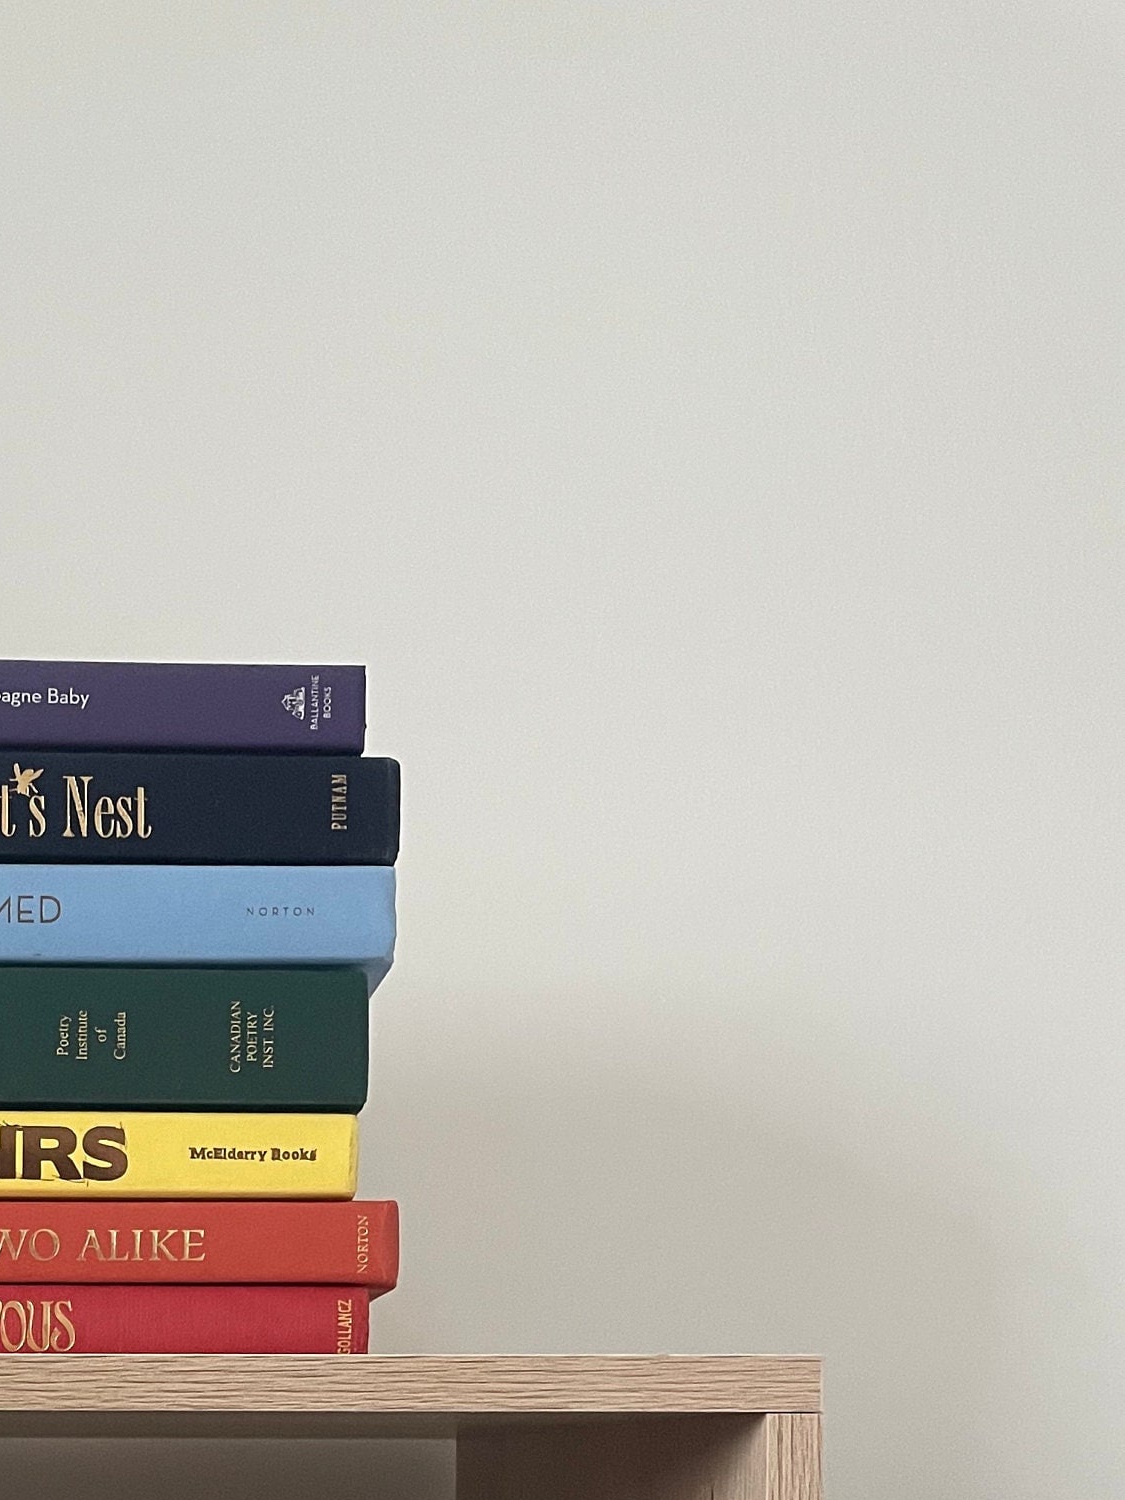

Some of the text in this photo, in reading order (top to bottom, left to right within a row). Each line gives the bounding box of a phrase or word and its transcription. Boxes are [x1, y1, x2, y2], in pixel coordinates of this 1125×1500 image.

[47, 688, 90, 709] Baby
[310, 675, 319, 730] BALLANTINE
[323, 686, 332, 719] BOOKS
[62, 775, 152, 839] Nest
[331, 774, 347, 830] PUTNAM
[247, 907, 315, 917] NORTON
[57, 1014, 72, 1056] Poetry
[76, 1010, 88, 1061] Institute
[96, 1026, 108, 1043] of
[114, 1011, 126, 1060] Canada
[230, 1000, 241, 1073] CANADIAN
[247, 1011, 257, 1061] POETRY
[189, 1147, 317, 1161] McElderry Books
[76, 1228, 206, 1262] ALIKE
[357, 1215, 369, 1274] NORTON
[337, 1299, 352, 1354] GOLLANCZ
